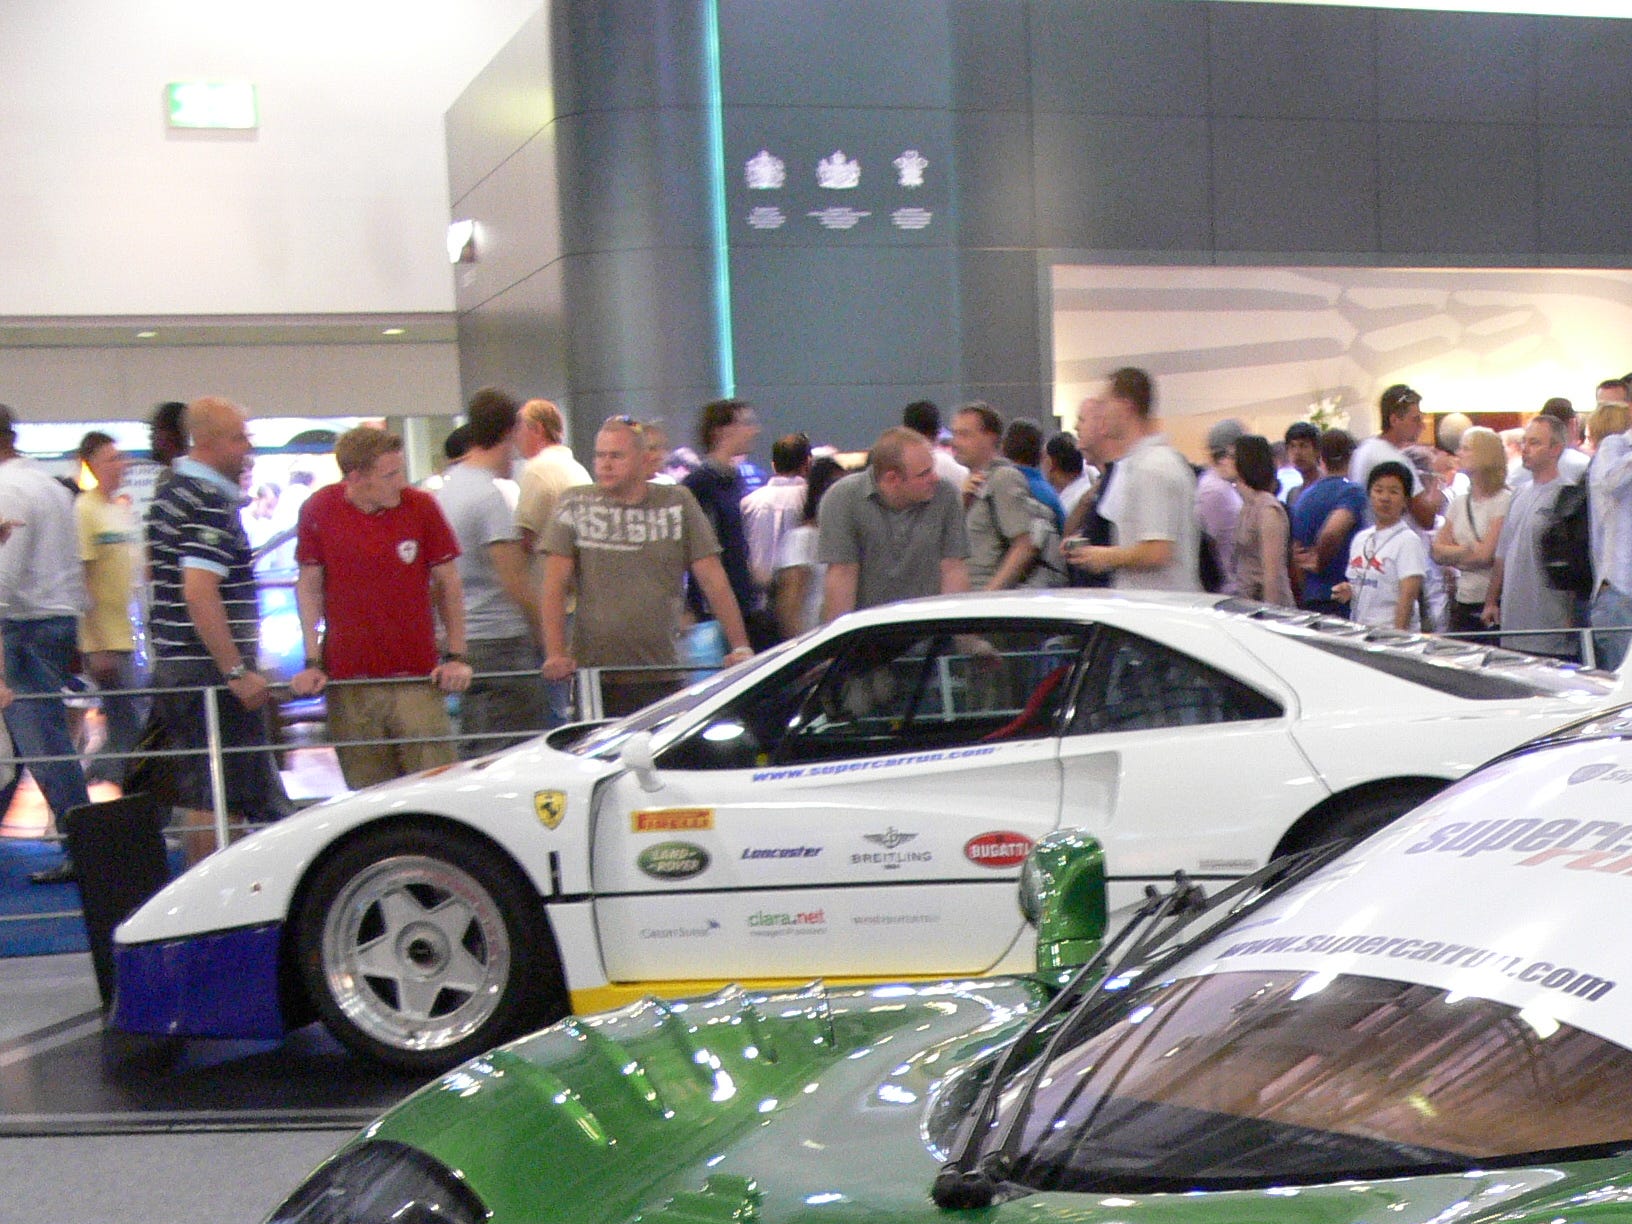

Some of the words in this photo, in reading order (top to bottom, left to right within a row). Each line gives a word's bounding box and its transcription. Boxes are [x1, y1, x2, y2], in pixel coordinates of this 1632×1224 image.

[638, 811, 710, 830] PIRELLI
[851, 851, 933, 864] BREITLING
[971, 843, 1030, 858] BUGATTI
[748, 908, 825, 926] clara.net
